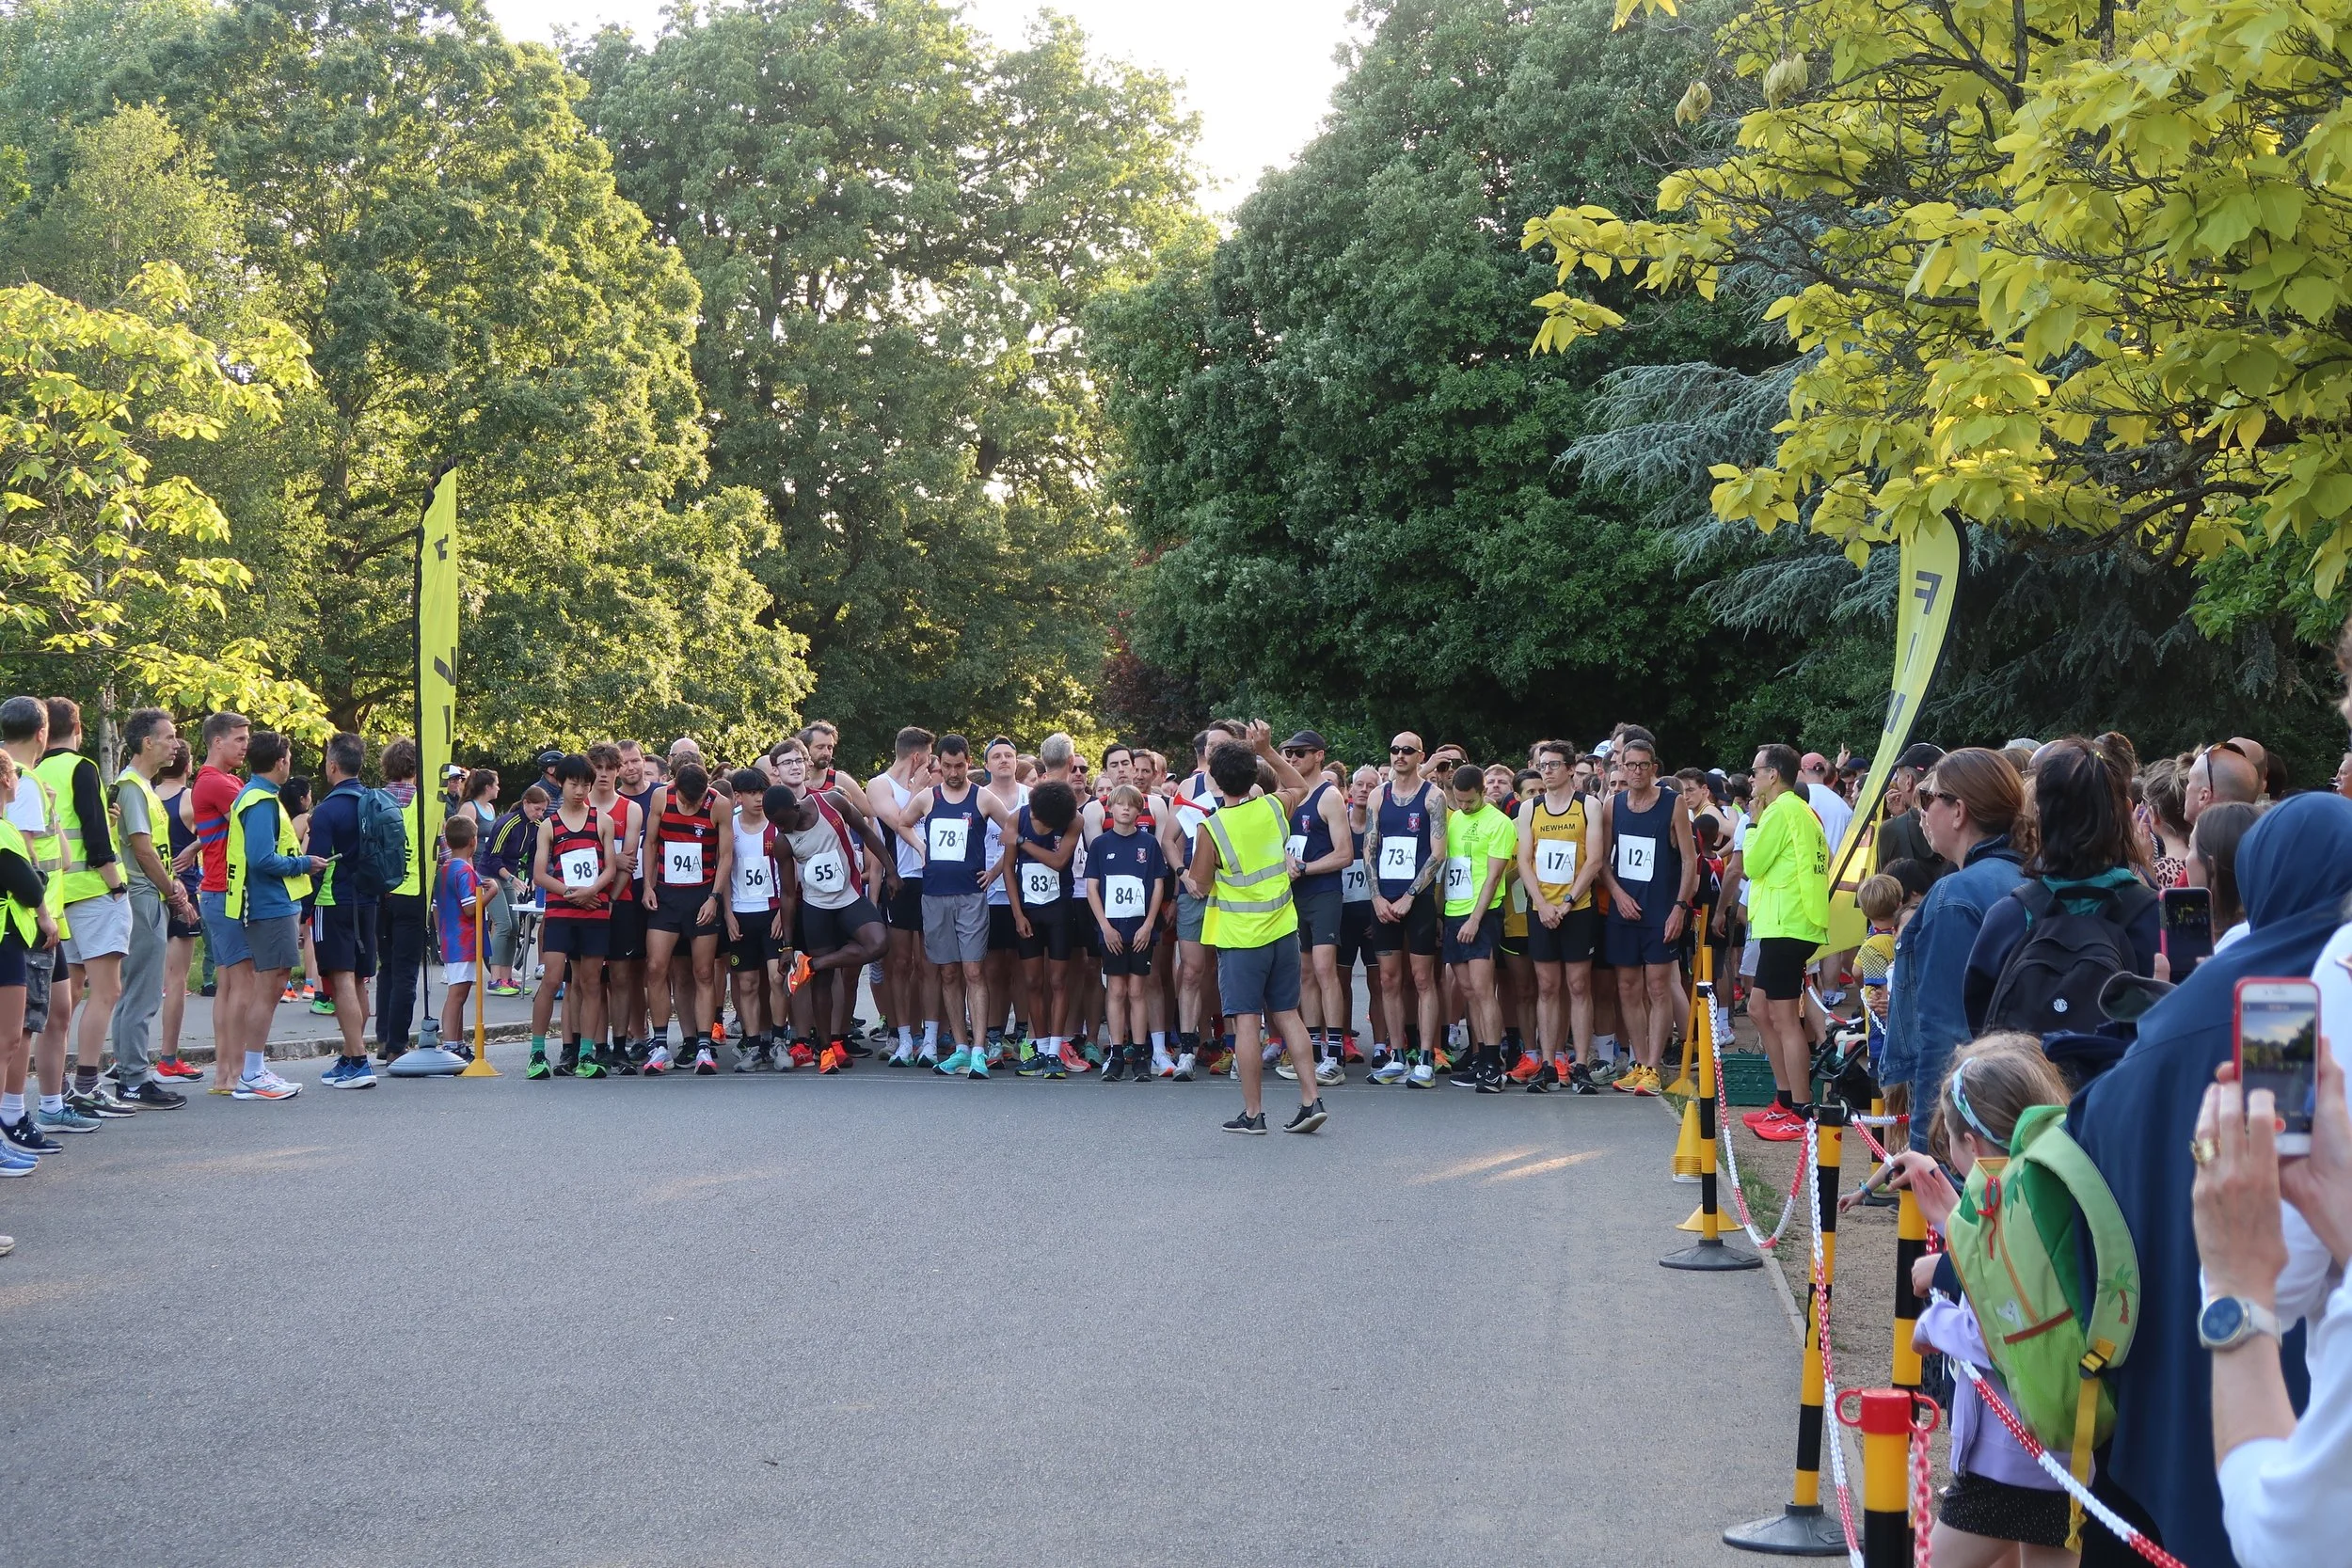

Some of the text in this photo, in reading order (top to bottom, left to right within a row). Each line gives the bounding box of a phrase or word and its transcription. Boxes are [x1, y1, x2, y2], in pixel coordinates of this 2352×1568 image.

[433, 533, 456, 861] FNIS
[1540, 823, 1576, 832] NEWHAM
[938, 831, 966, 849] 78A
[673, 855, 703, 872] 94A
[1388, 848, 1416, 866] 73A
[1548, 852, 1574, 871] 17A
[1629, 847, 1653, 869] 12A
[745, 868, 772, 886] 56A
[815, 862, 844, 882] 55A
[1346, 871, 1366, 889] 79
[1449, 868, 1471, 886] 57A
[1030, 875, 1060, 893] 83A
[1115, 887, 1145, 905] 84A
